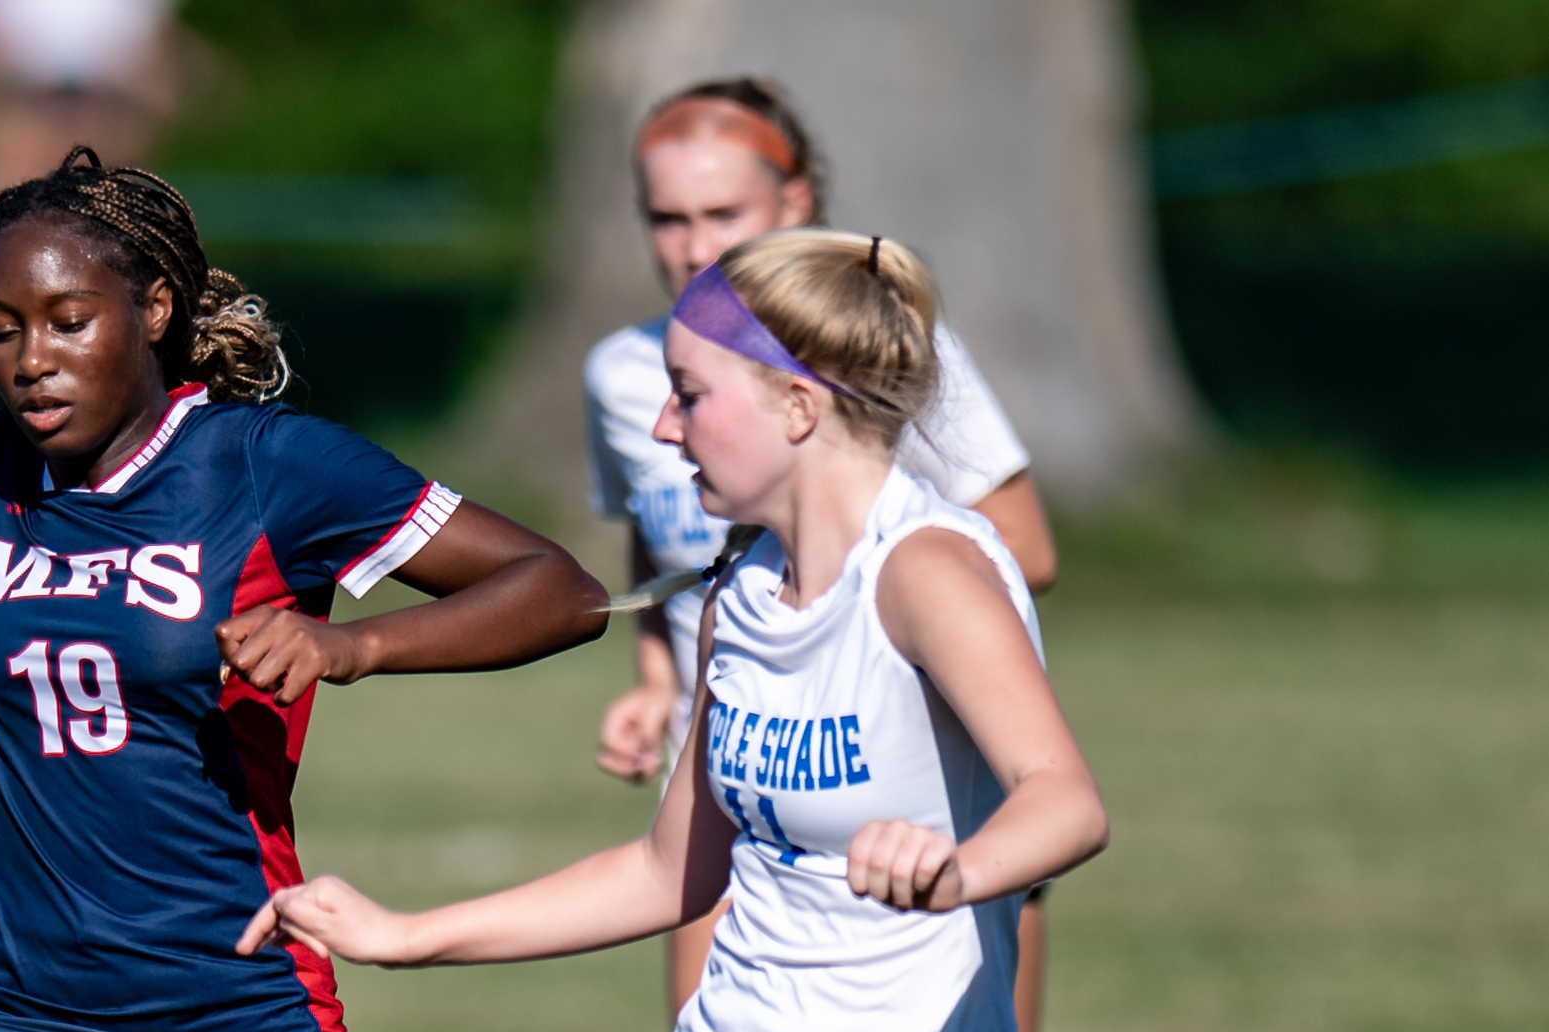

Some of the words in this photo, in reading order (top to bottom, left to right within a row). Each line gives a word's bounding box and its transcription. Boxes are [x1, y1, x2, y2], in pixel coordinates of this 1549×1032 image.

[8, 639, 131, 756] 19
[708, 701, 761, 783] PLE
[756, 714, 871, 791] SHADE
